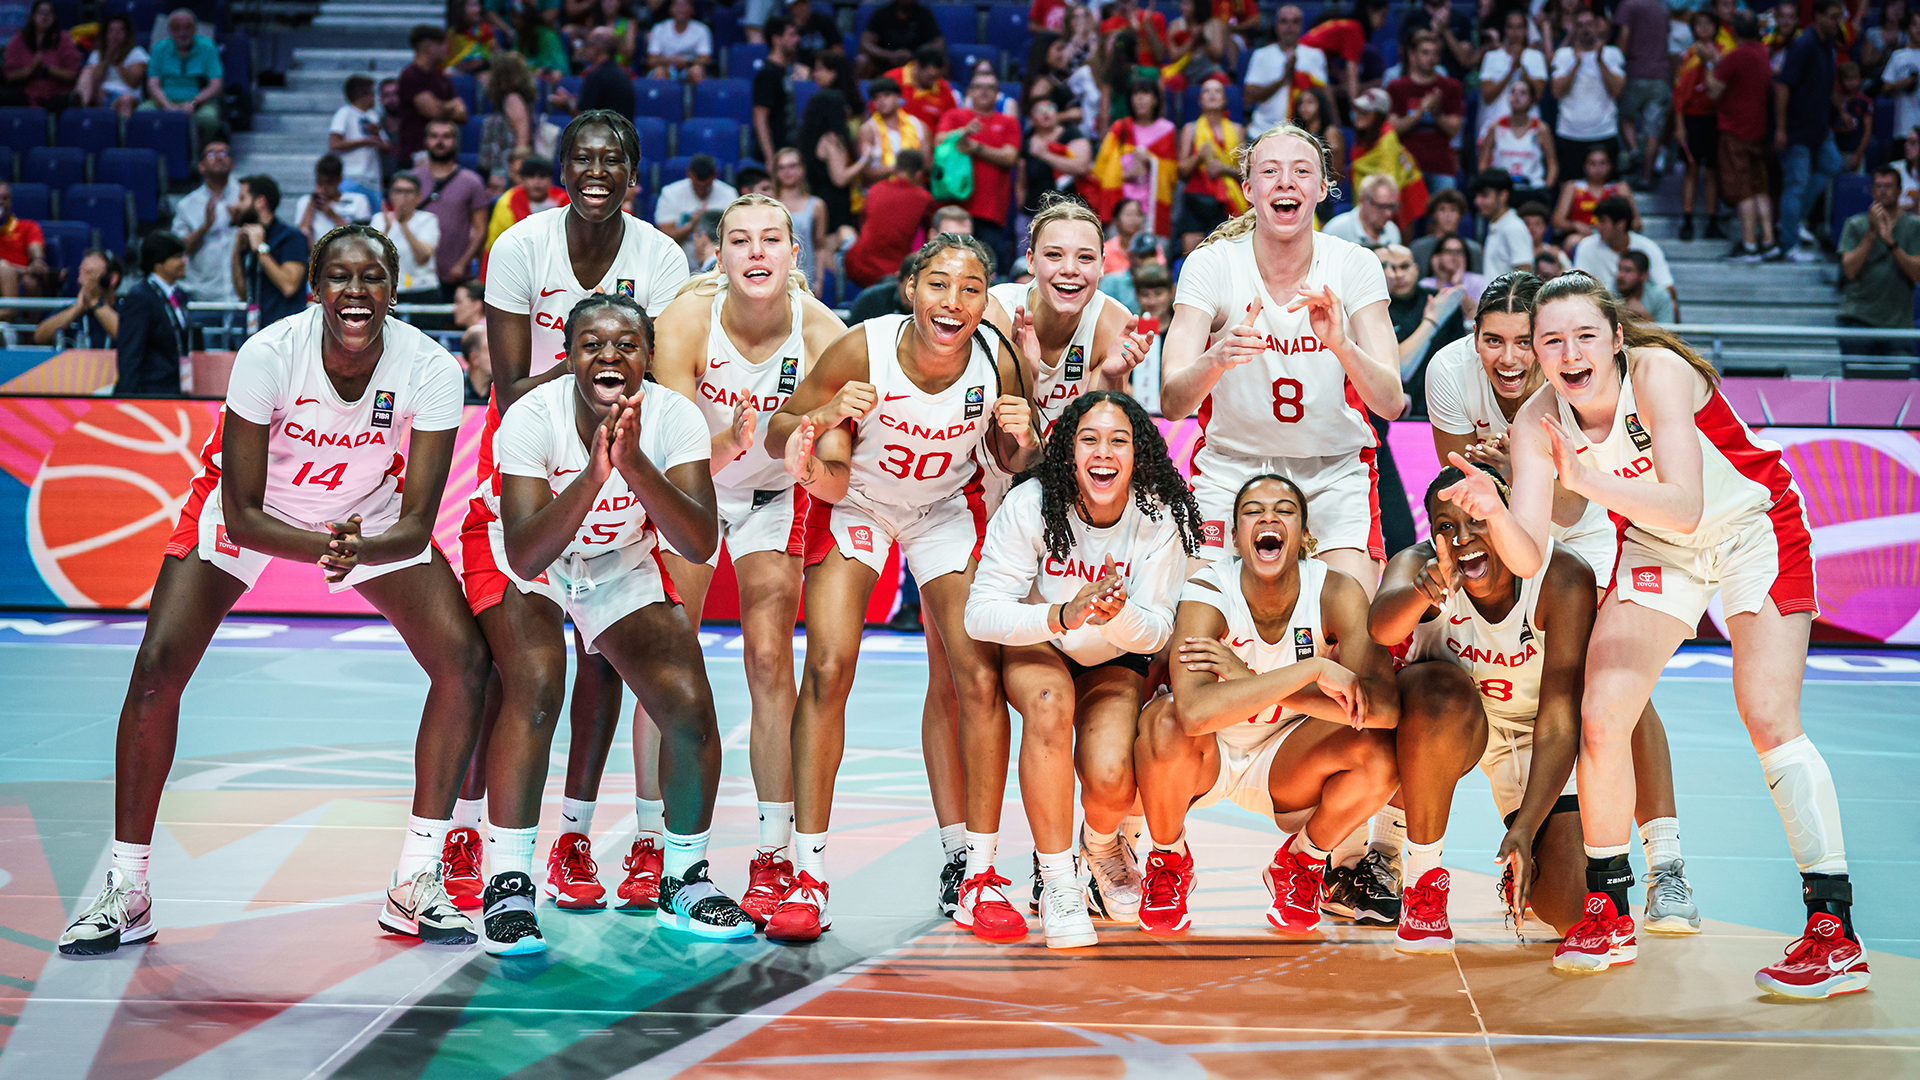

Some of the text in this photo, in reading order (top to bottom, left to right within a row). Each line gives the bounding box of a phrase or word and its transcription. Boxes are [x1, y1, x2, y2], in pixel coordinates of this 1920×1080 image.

[1258, 334, 1330, 355] ANADA
[1272, 377, 1304, 423] 8
[284, 422, 386, 449] CANADA
[879, 414, 976, 441] CANADA
[292, 461, 348, 491] 14
[878, 444, 952, 481] 30
[219, 541, 238, 551] TOYOTA
[1446, 637, 1537, 667] CANADA
